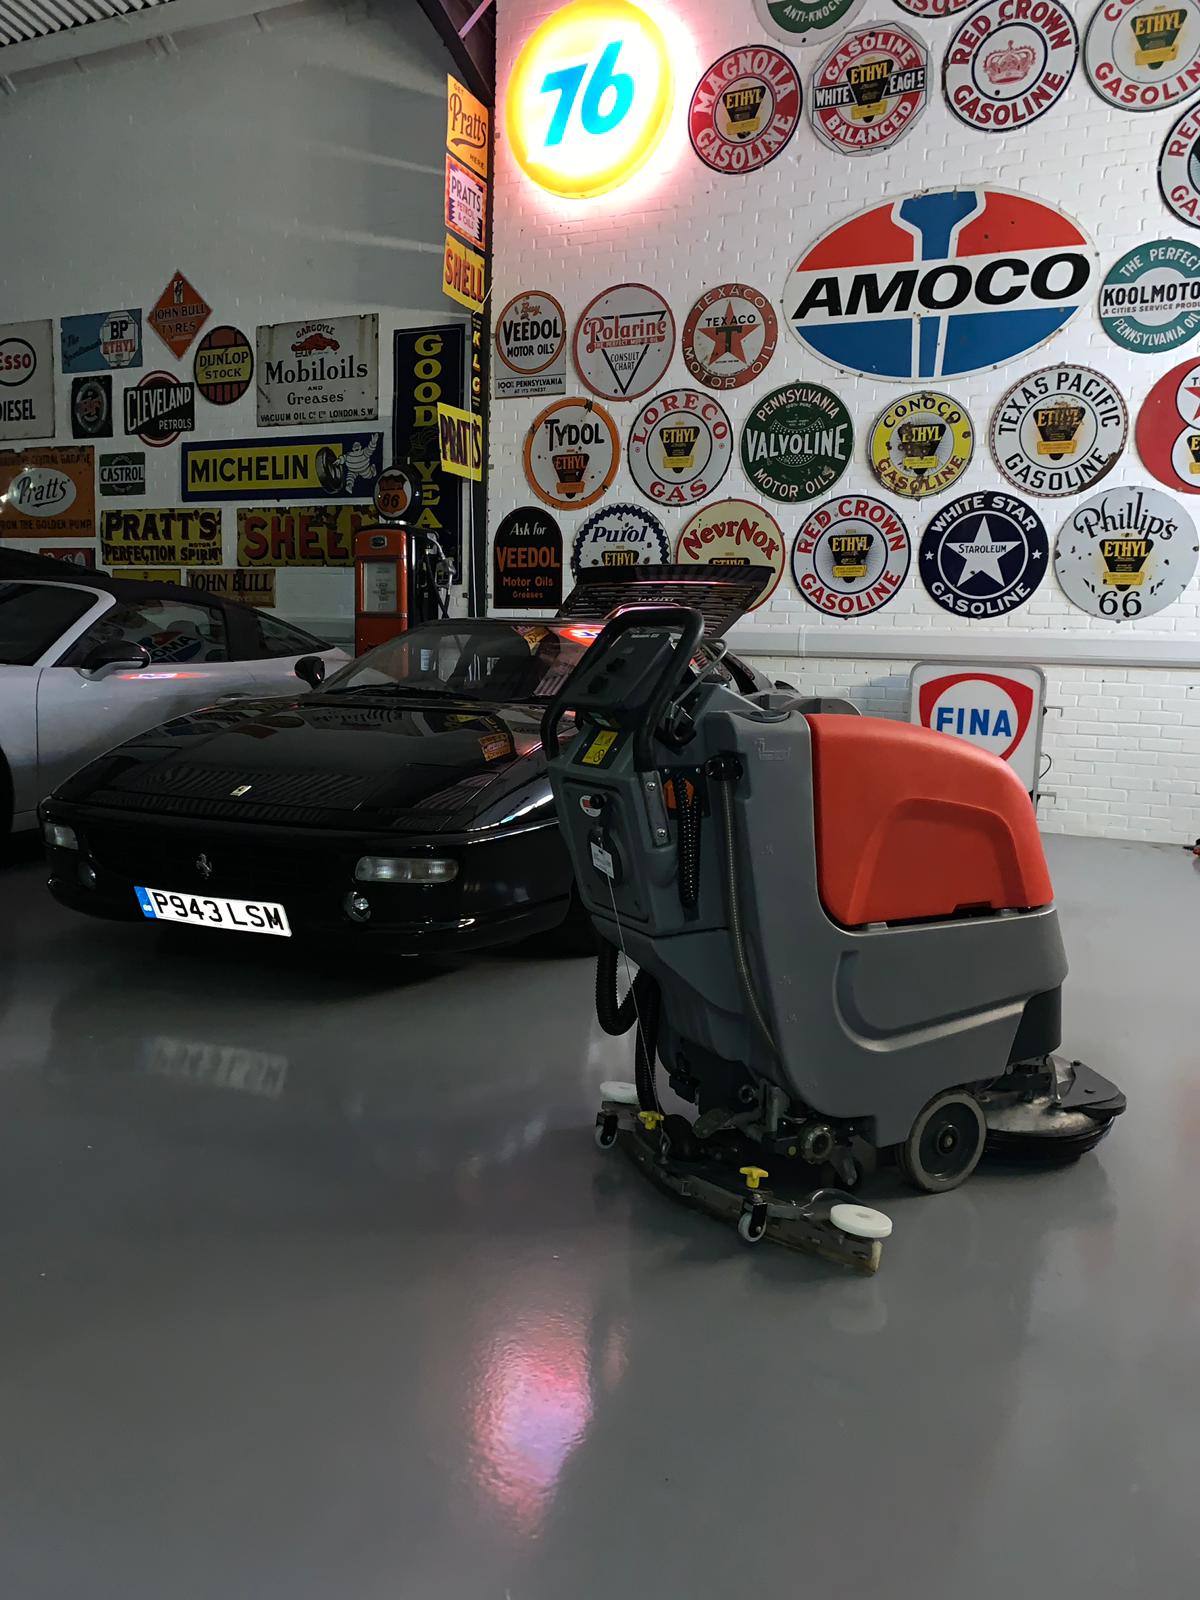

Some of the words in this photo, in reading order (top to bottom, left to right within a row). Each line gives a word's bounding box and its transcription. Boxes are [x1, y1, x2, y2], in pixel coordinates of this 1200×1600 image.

[950, 15, 992, 65] RED
[998, 0, 1072, 50] CROWN
[1135, 12, 1181, 36] ETHYL
[825, 33, 916, 81] GASOLINE
[694, 50, 796, 115] MAGNOLIA
[851, 61, 892, 85] ETHYL
[1095, 58, 1200, 105] GASOLIN
[539, 39, 635, 147] 76
[726, 88, 762, 109] ETHYL
[815, 84, 850, 108] WHITE
[889, 70, 924, 94] EAGLE
[954, 71, 1066, 126] GASOLINE
[449, 92, 487, 149] Pratts
[825, 101, 912, 144] BALANCED
[696, 113, 794, 171] GASOLINE
[451, 175, 481, 213] PRATTS
[457, 200, 476, 220] PETROL
[1119, 255, 1144, 277] THE
[695, 285, 766, 312] TEXACO
[791, 252, 1091, 321] AMOCO
[1103, 282, 1200, 307] KOOLMOTO
[156, 306, 179, 321] JOHN
[181, 303, 205, 317] BULL
[705, 314, 757, 328] TEXACO
[1111, 306, 1137, 314] CITIES
[1139, 303, 1173, 312] SERVICE
[110, 319, 129, 340] BP
[161, 321, 196, 335] TYRES
[295, 323, 336, 339] GARGOYLE
[502, 316, 561, 346] VEEDOL
[583, 315, 667, 354] Polarine
[1112, 318, 1187, 346] PENNSYLVANIA
[103, 339, 136, 354] ETHYL
[199, 351, 249, 369] DUNLOP
[507, 345, 534, 358] MOTOR
[537, 343, 555, 355] OILS
[610, 351, 640, 363] CONSULT
[205, 367, 242, 380] STOCK
[264, 354, 369, 386] Mobiloils
[615, 361, 635, 371] CHART
[684, 346, 736, 388] MOTOR
[751, 341, 776, 374] OIL
[516, 377, 563, 388] PENNSYLVANIA
[126, 386, 192, 432] CLEVELAND
[287, 391, 345, 406] Greases
[756, 388, 840, 422] PENNSYLVANIA
[998, 376, 1049, 436] TEXAS
[1056, 372, 1120, 428] PACIFIC
[158, 418, 192, 431] PETROLS
[260, 413, 292, 423] VACUUM
[294, 411, 306, 421] OIL
[632, 393, 728, 445] LORECO
[883, 397, 962, 429] CONOCO
[544, 418, 605, 452] TYDOL
[662, 429, 697, 443] ETHYL
[746, 423, 848, 463] VALVOLINE
[101, 466, 144, 482] CASTROL
[191, 455, 308, 483] MICHELIN
[555, 455, 586, 471] ETHYL
[875, 454, 964, 494] GASOLINE
[1005, 447, 1109, 491] GASOLINE
[17, 475, 71, 508] Pratts
[650, 478, 708, 502] GAS
[753, 468, 799, 498] MOTOR
[805, 470, 836, 494] OILS
[382, 493, 399, 508] 66
[105, 510, 218, 541] PRATT'S
[509, 522, 530, 536] Ask
[531, 521, 547, 536] for
[797, 510, 832, 554] RED
[838, 499, 906, 552] CROWN
[930, 495, 986, 535] WHITE
[991, 496, 1038, 532] STAR
[590, 525, 648, 544] Purol
[683, 517, 780, 561] NevrNox
[831, 536, 870, 552] ETHYL
[105, 544, 176, 562] PERFECTION
[496, 545, 561, 573] VEEDOL
[604, 552, 637, 567] ETHYL
[1104, 540, 1150, 557] ETHYL
[190, 573, 228, 592] JOHN
[232, 573, 273, 592] BULL
[502, 576, 531, 588] Motor
[534, 575, 553, 588] Oils
[512, 590, 544, 599] Greases
[800, 570, 902, 614] GASOLINE
[931, 582, 1031, 615] GASOLINE
[1099, 590, 1142, 616] 66
[936, 707, 1012, 737] FINA
[151, 891, 223, 923] P943
[226, 902, 285, 930] LSM
